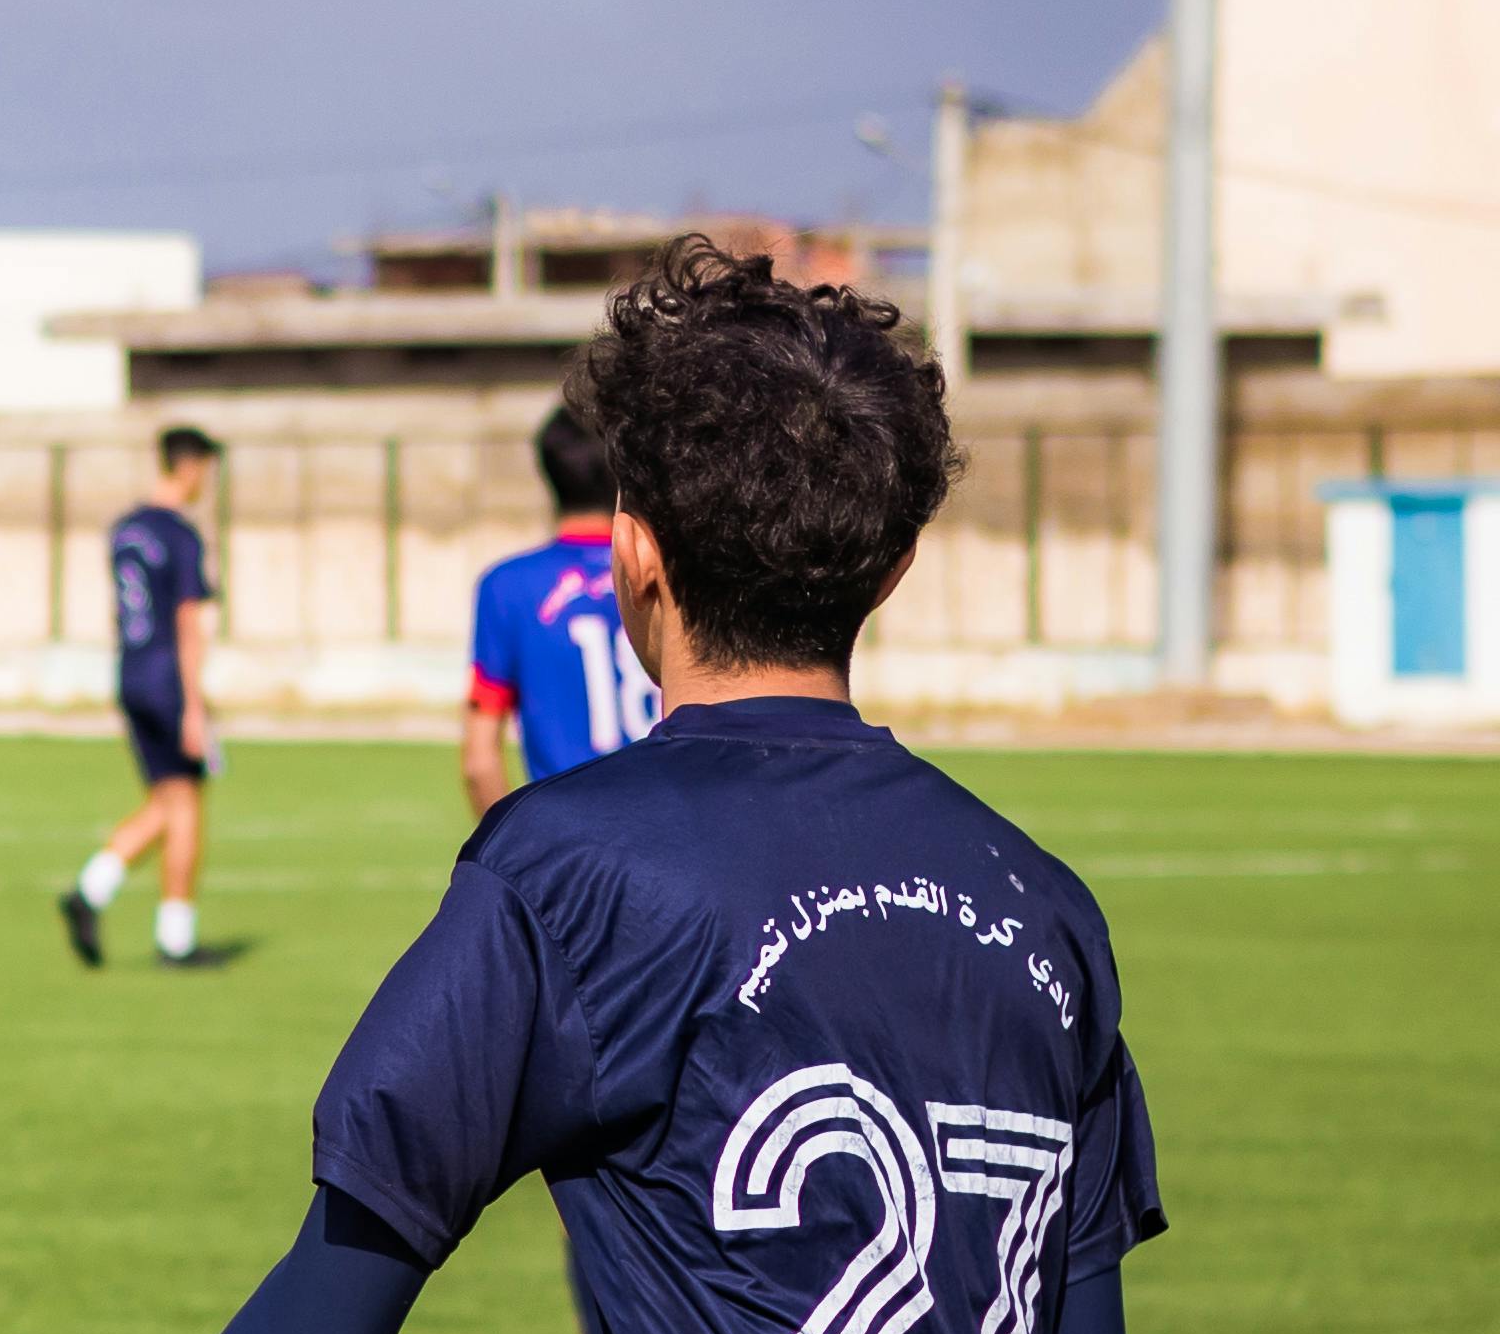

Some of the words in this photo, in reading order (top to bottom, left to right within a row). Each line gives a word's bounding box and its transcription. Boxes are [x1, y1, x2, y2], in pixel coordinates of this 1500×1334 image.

[791, 885, 870, 941] بمنزل
[873, 876, 948, 920] القدم
[957, 893, 1024, 947] كرة
[738, 918, 789, 1014] تميم
